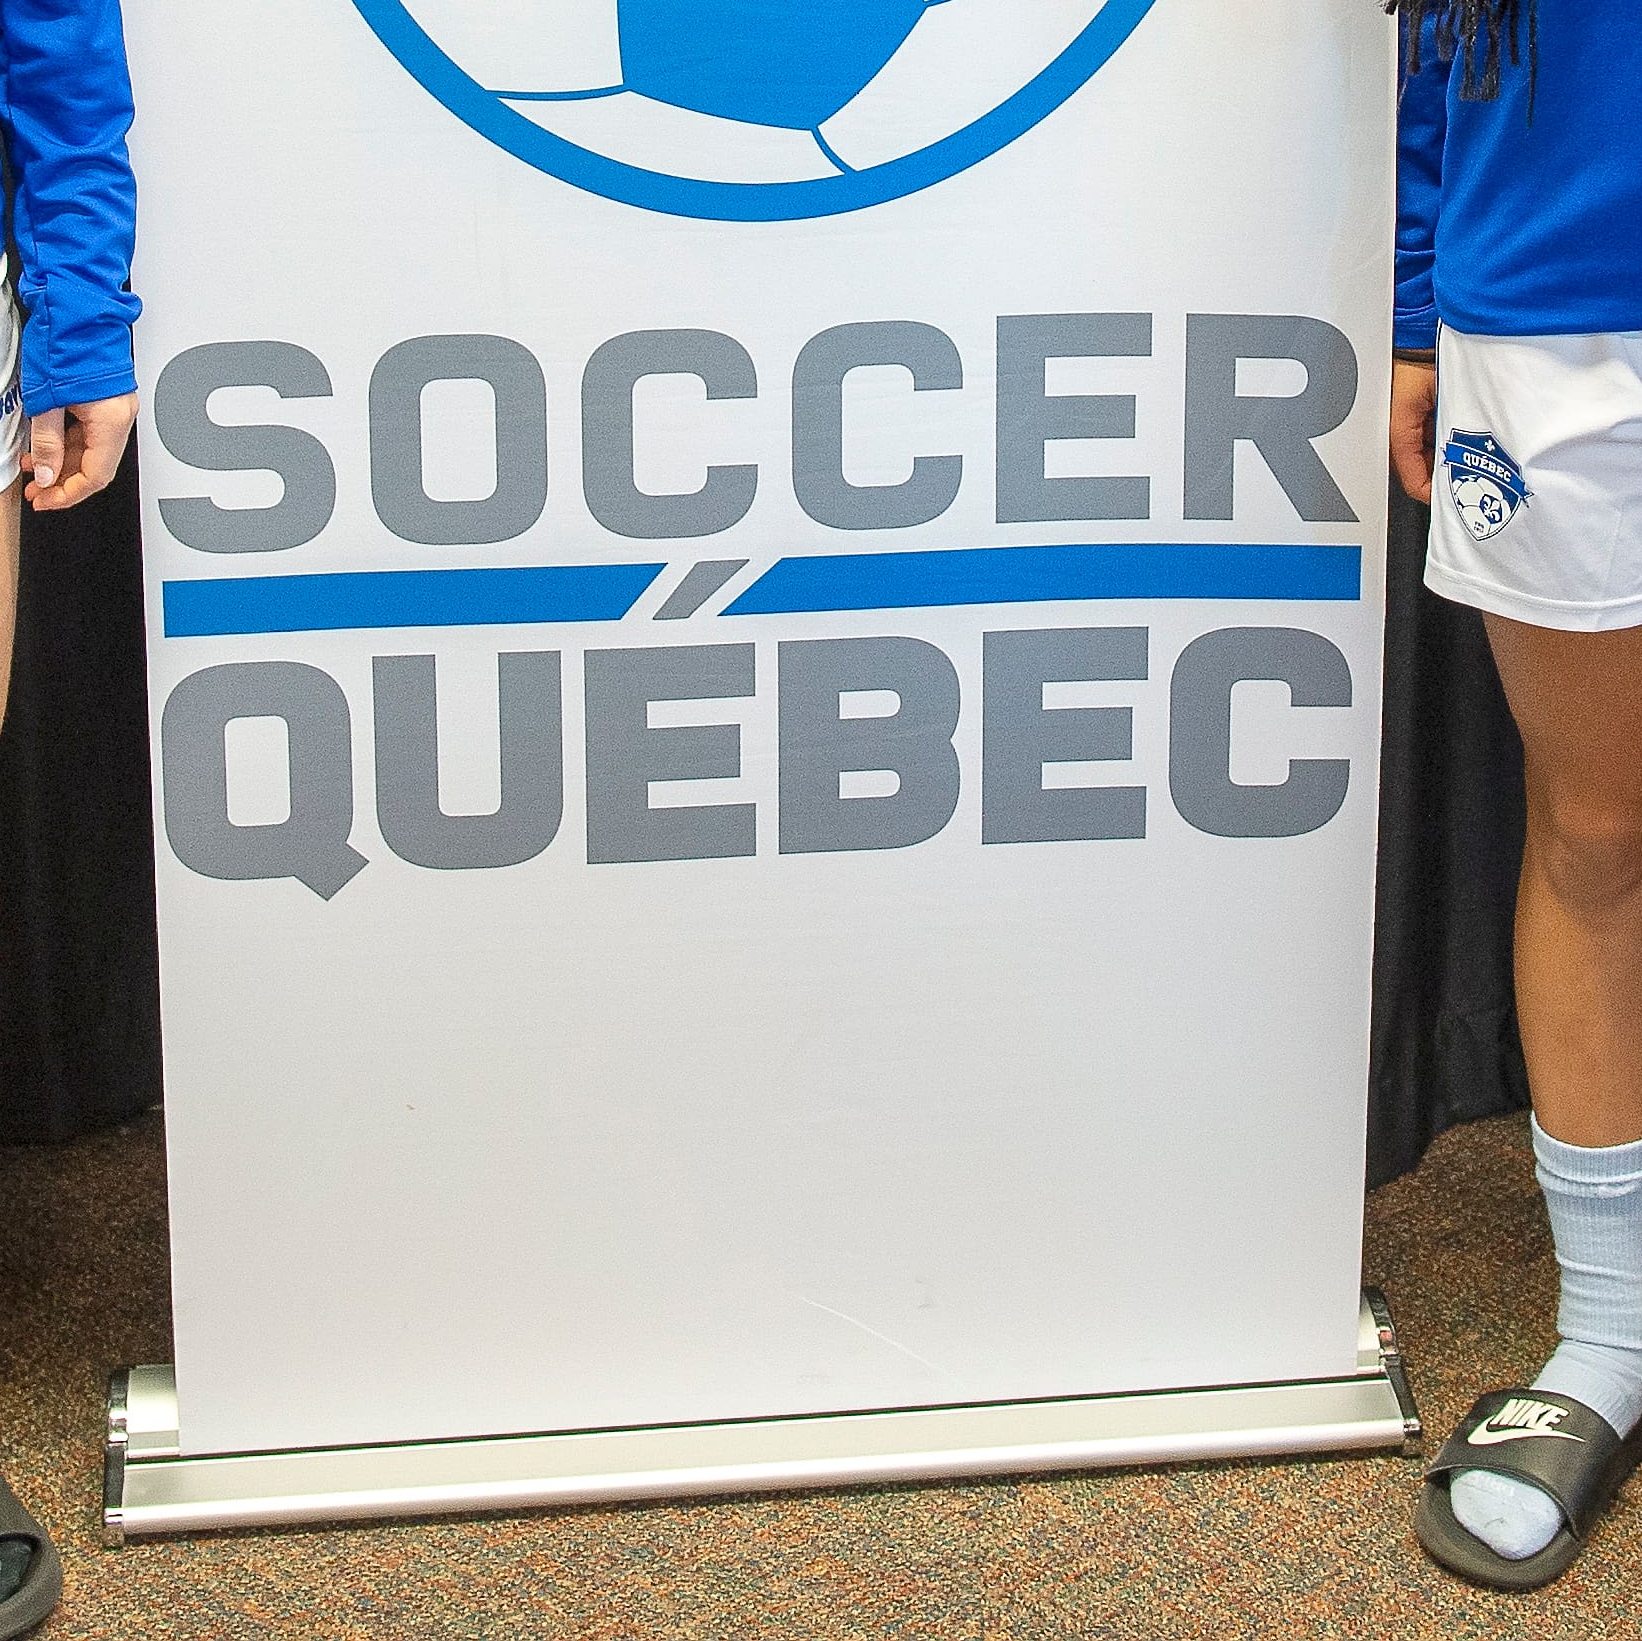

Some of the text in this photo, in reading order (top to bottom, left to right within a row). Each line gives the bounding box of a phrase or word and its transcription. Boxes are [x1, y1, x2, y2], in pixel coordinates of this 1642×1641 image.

[154, 312, 1361, 555] SOCCER
[1463, 451, 1512, 482] QUÉBEC
[161, 559, 1353, 901] QUÉBEC
[1490, 1398, 1571, 1432] NIKE
